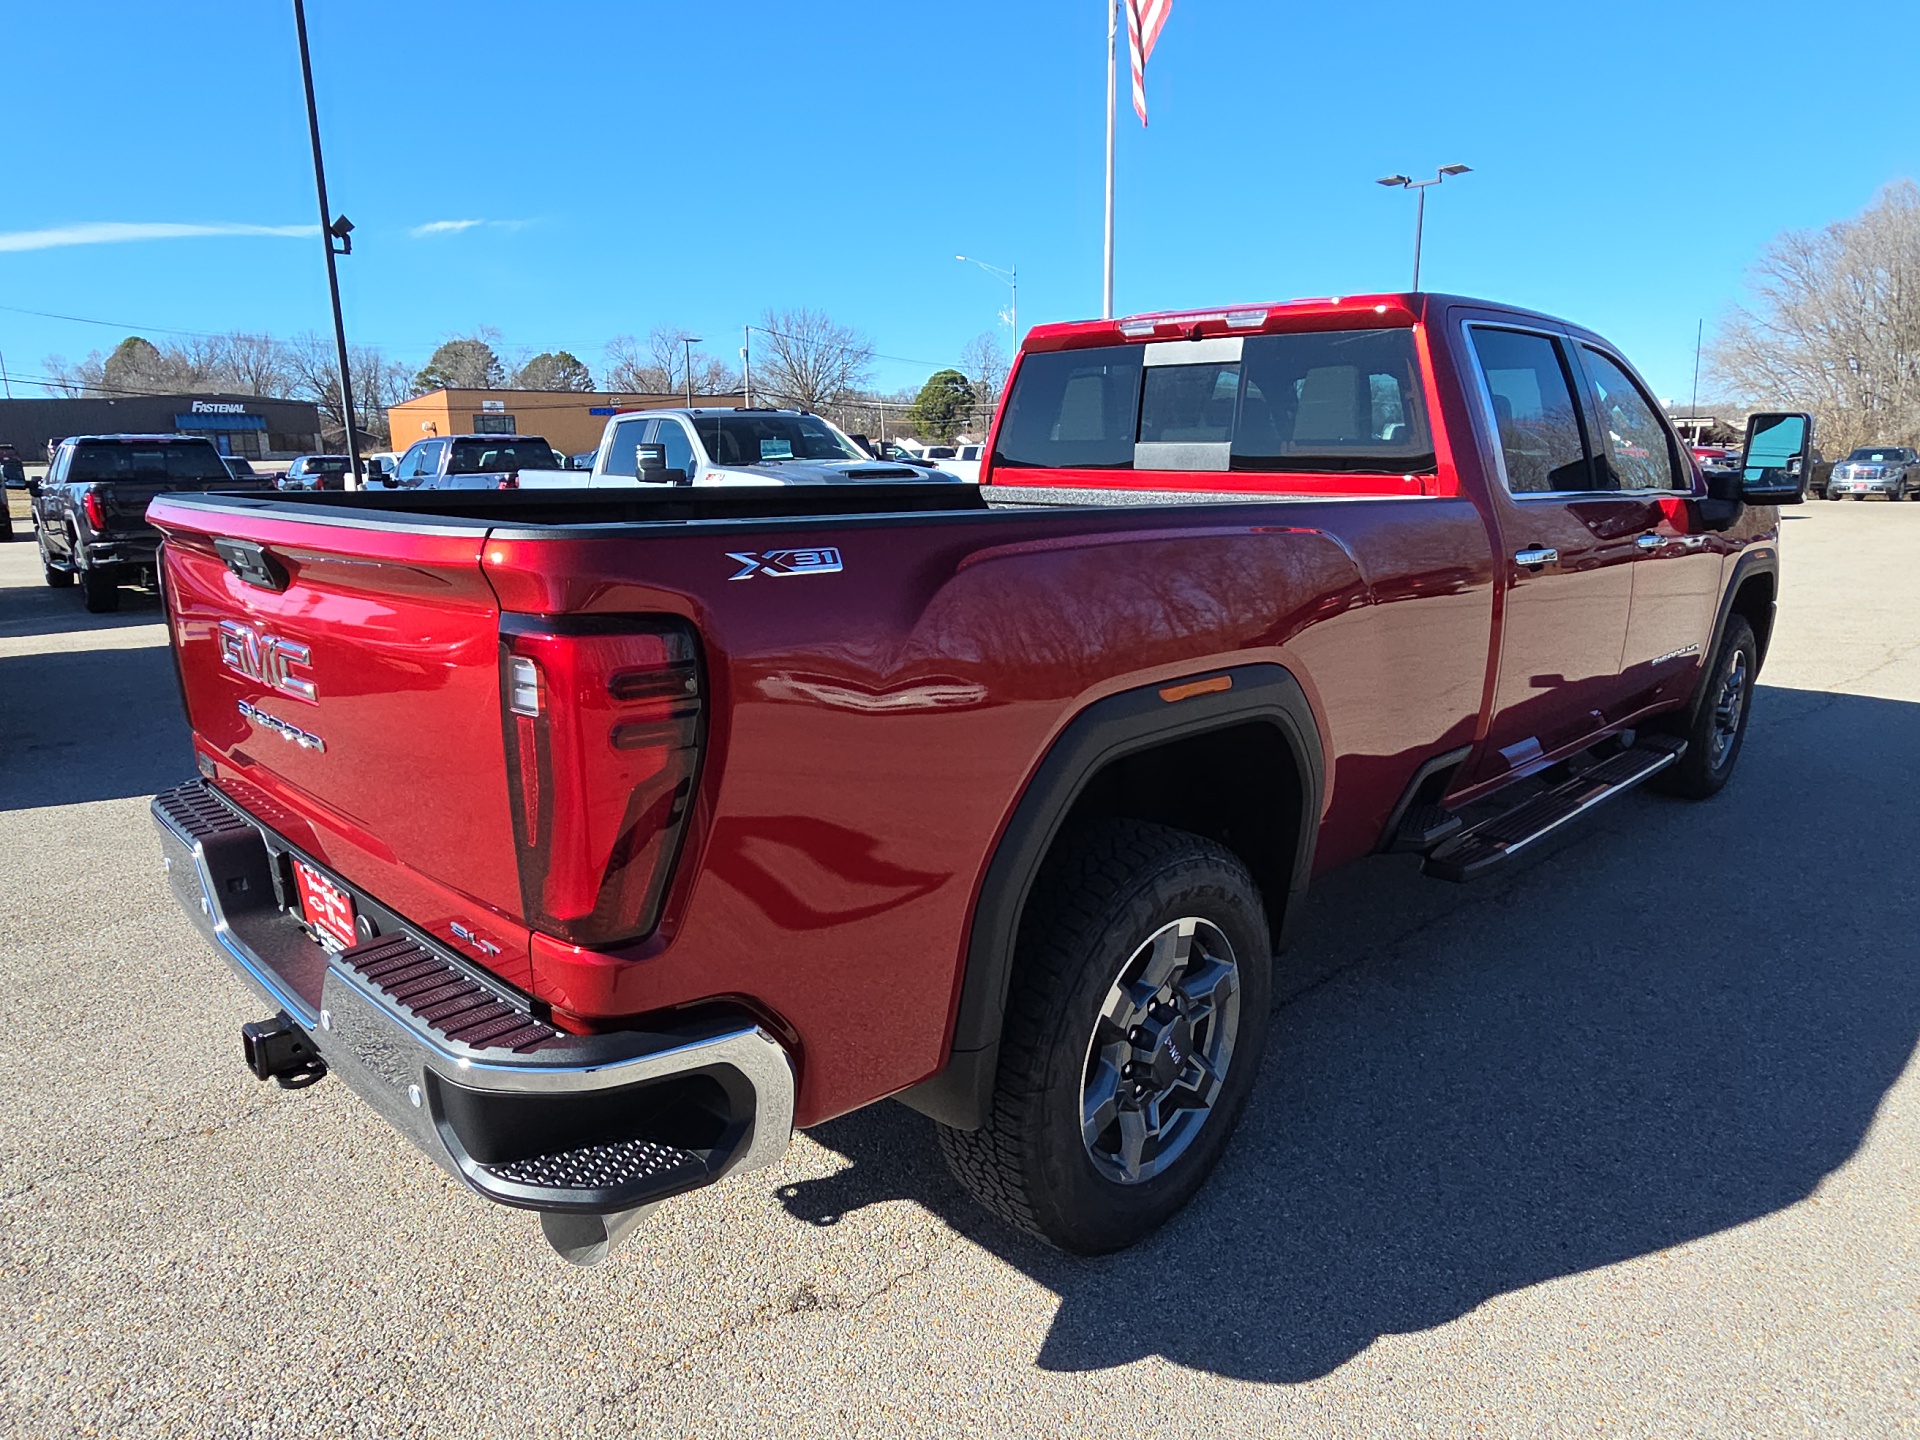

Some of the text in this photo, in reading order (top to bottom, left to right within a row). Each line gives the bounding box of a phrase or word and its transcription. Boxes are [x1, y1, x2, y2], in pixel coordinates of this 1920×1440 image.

[191, 400, 246, 413] FASTENAL
[724, 546, 844, 581] X31
[218, 620, 320, 706] GMC
[237, 698, 327, 753] SIERRA
[449, 921, 501, 957] SLT
